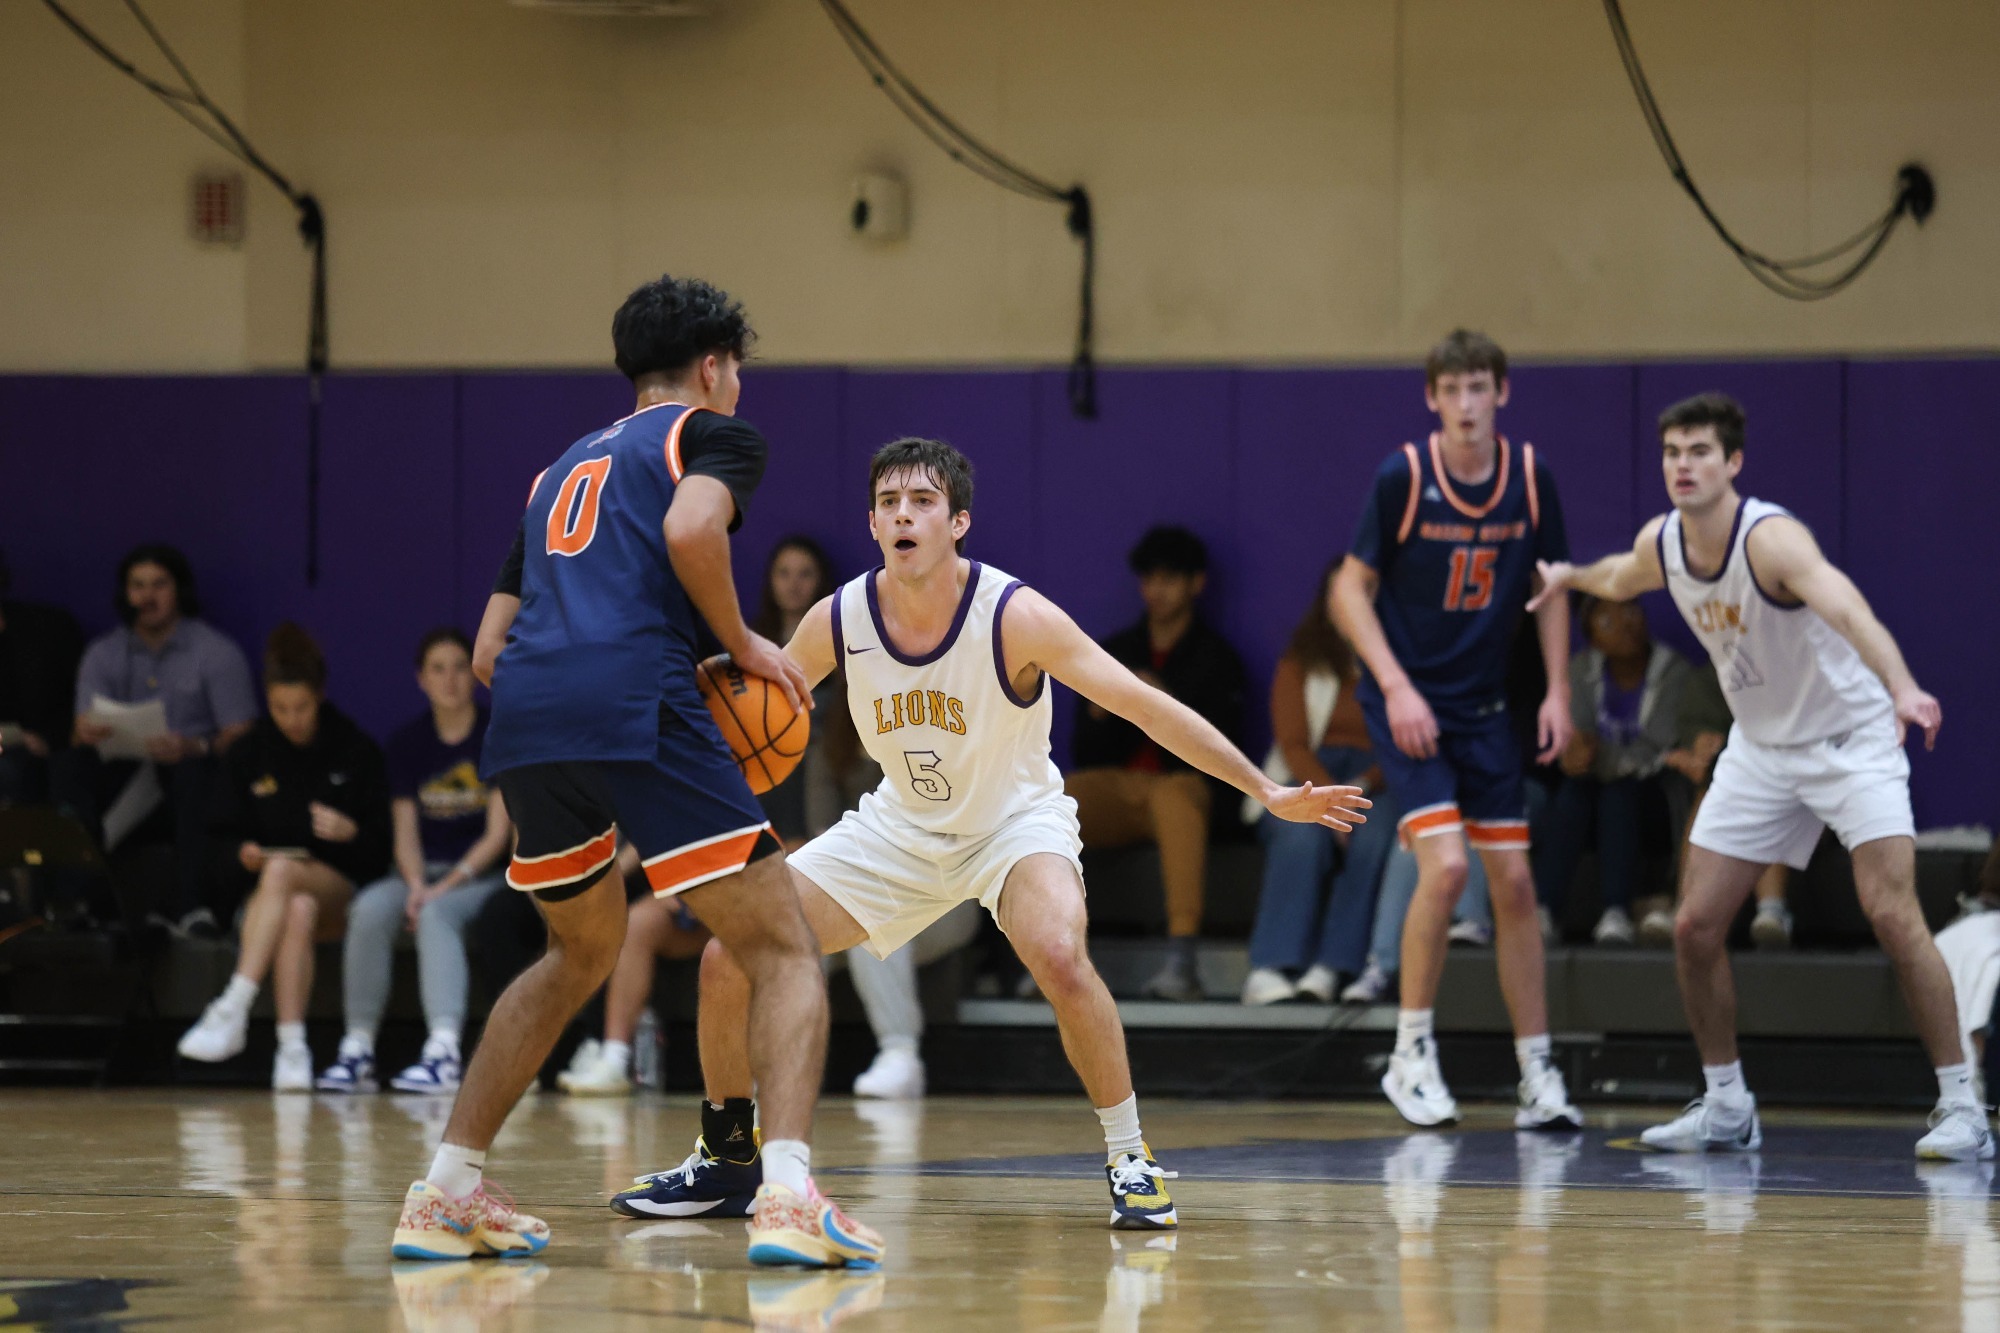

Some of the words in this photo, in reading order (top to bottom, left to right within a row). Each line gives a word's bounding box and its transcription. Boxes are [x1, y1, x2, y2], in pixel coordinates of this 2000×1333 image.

[546, 454, 612, 557] 0
[1443, 547, 1499, 612] 15
[874, 689, 966, 735] LIONS
[903, 750, 952, 801] 5
